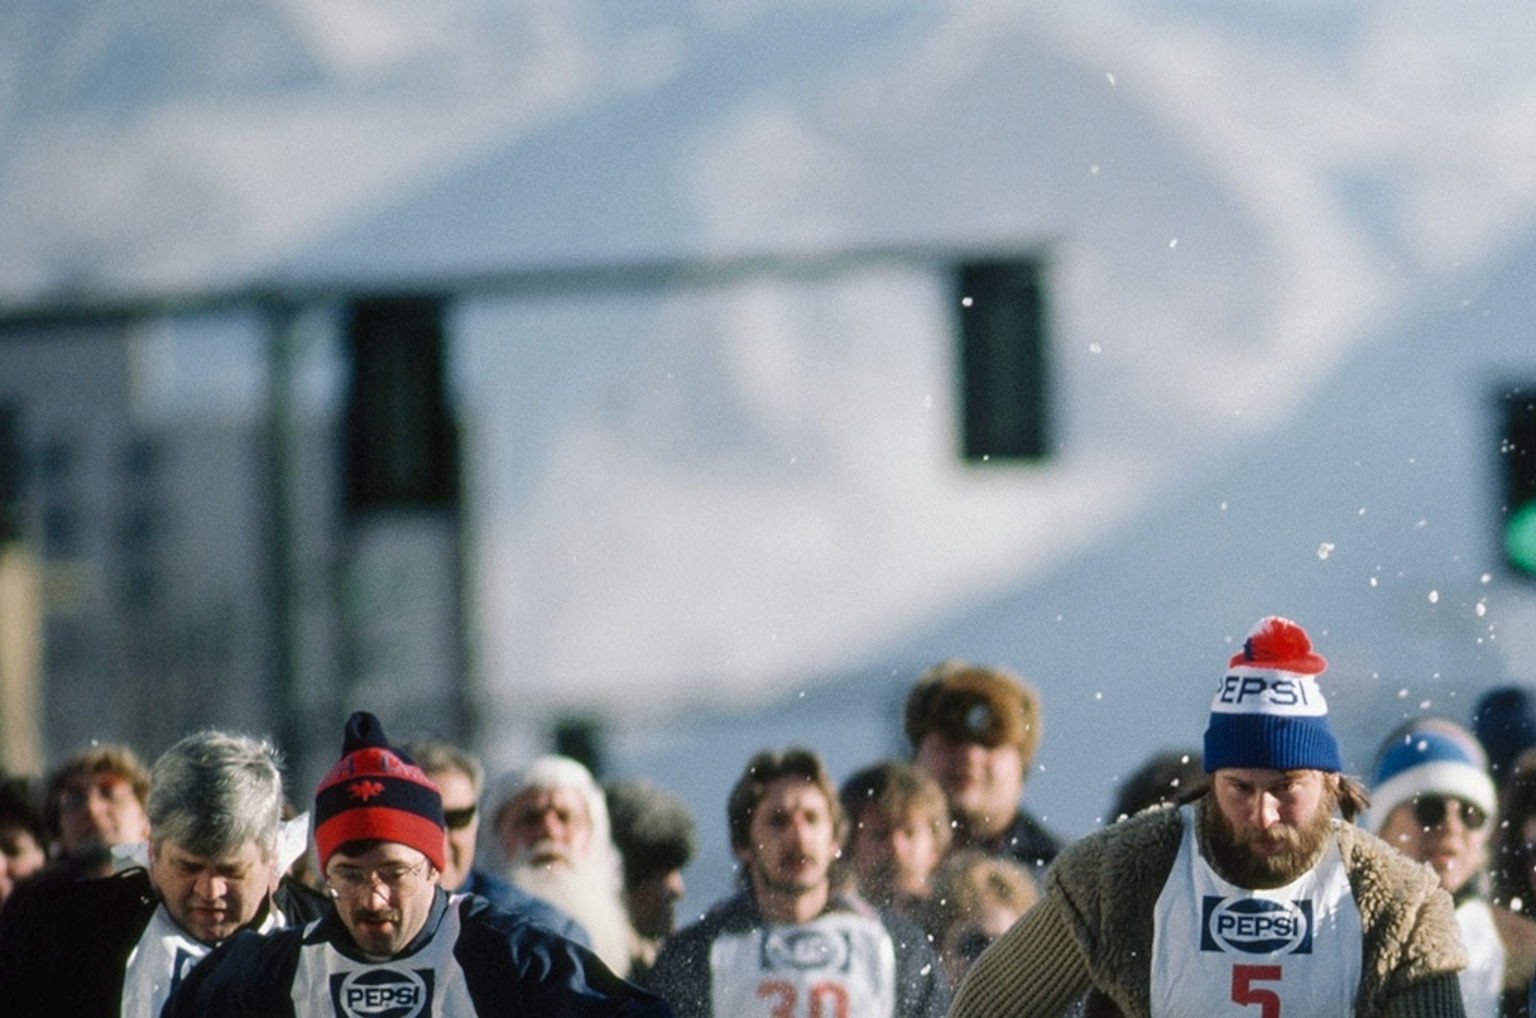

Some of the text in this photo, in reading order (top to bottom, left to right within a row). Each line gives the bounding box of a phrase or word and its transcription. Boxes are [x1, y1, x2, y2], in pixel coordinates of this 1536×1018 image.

[1216, 675, 1309, 706] EPSI
[1217, 914, 1299, 937] PEPSI
[346, 986, 420, 1008] PEPSI
